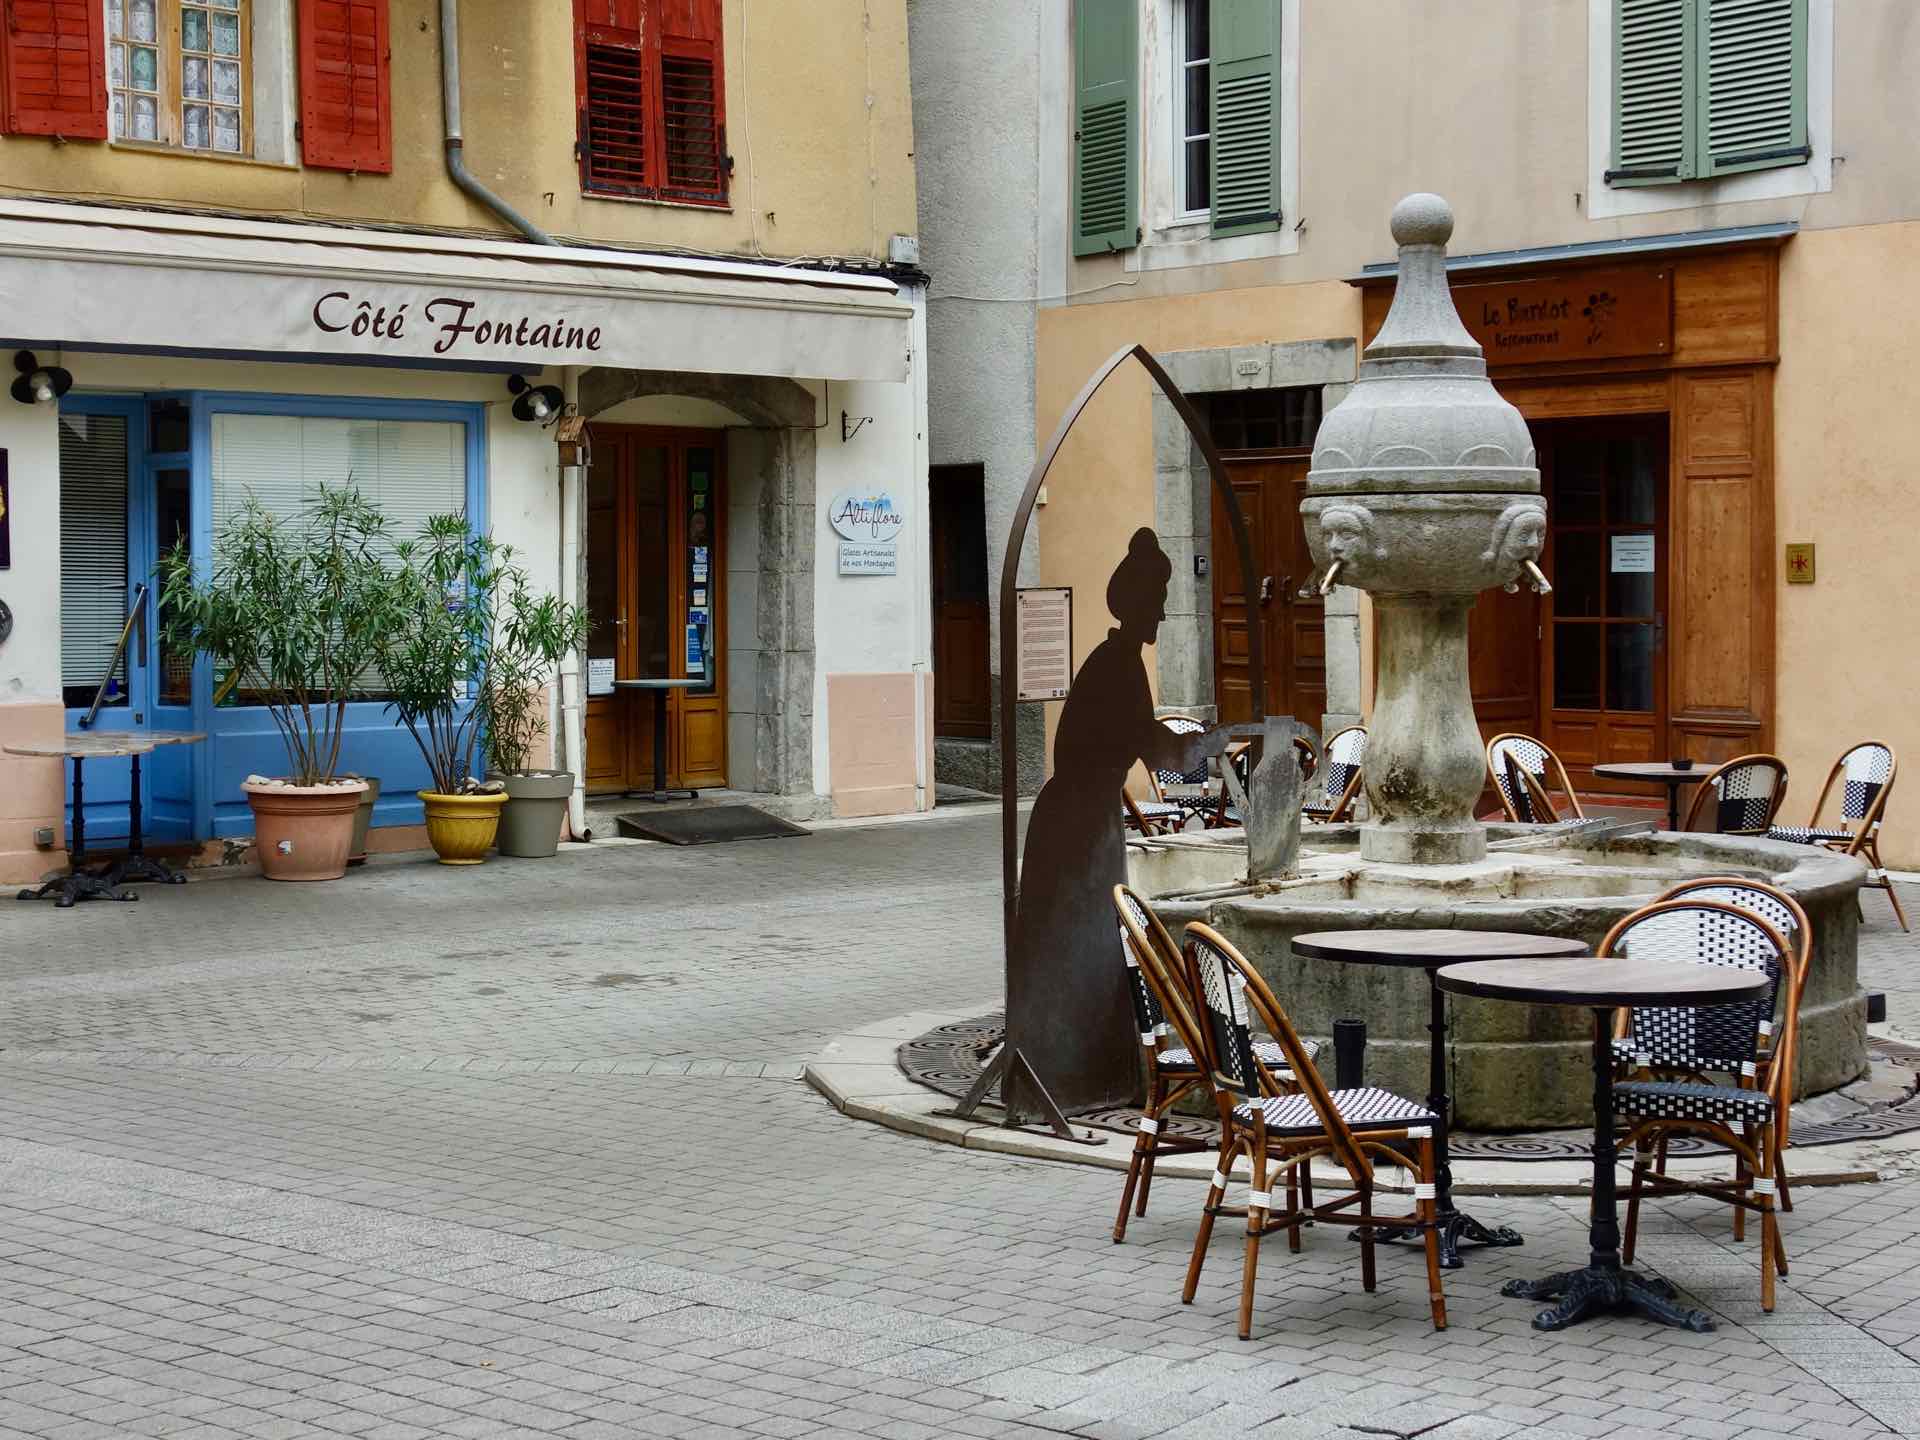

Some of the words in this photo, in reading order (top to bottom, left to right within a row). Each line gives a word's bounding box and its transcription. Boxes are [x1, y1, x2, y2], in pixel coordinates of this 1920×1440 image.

[313, 292, 408, 339] Côté
[425, 298, 601, 353] Fontaine
[1483, 301, 1500, 326] Le
[1496, 331, 1559, 347] Restaurant
[833, 500, 902, 538] Altiflore
